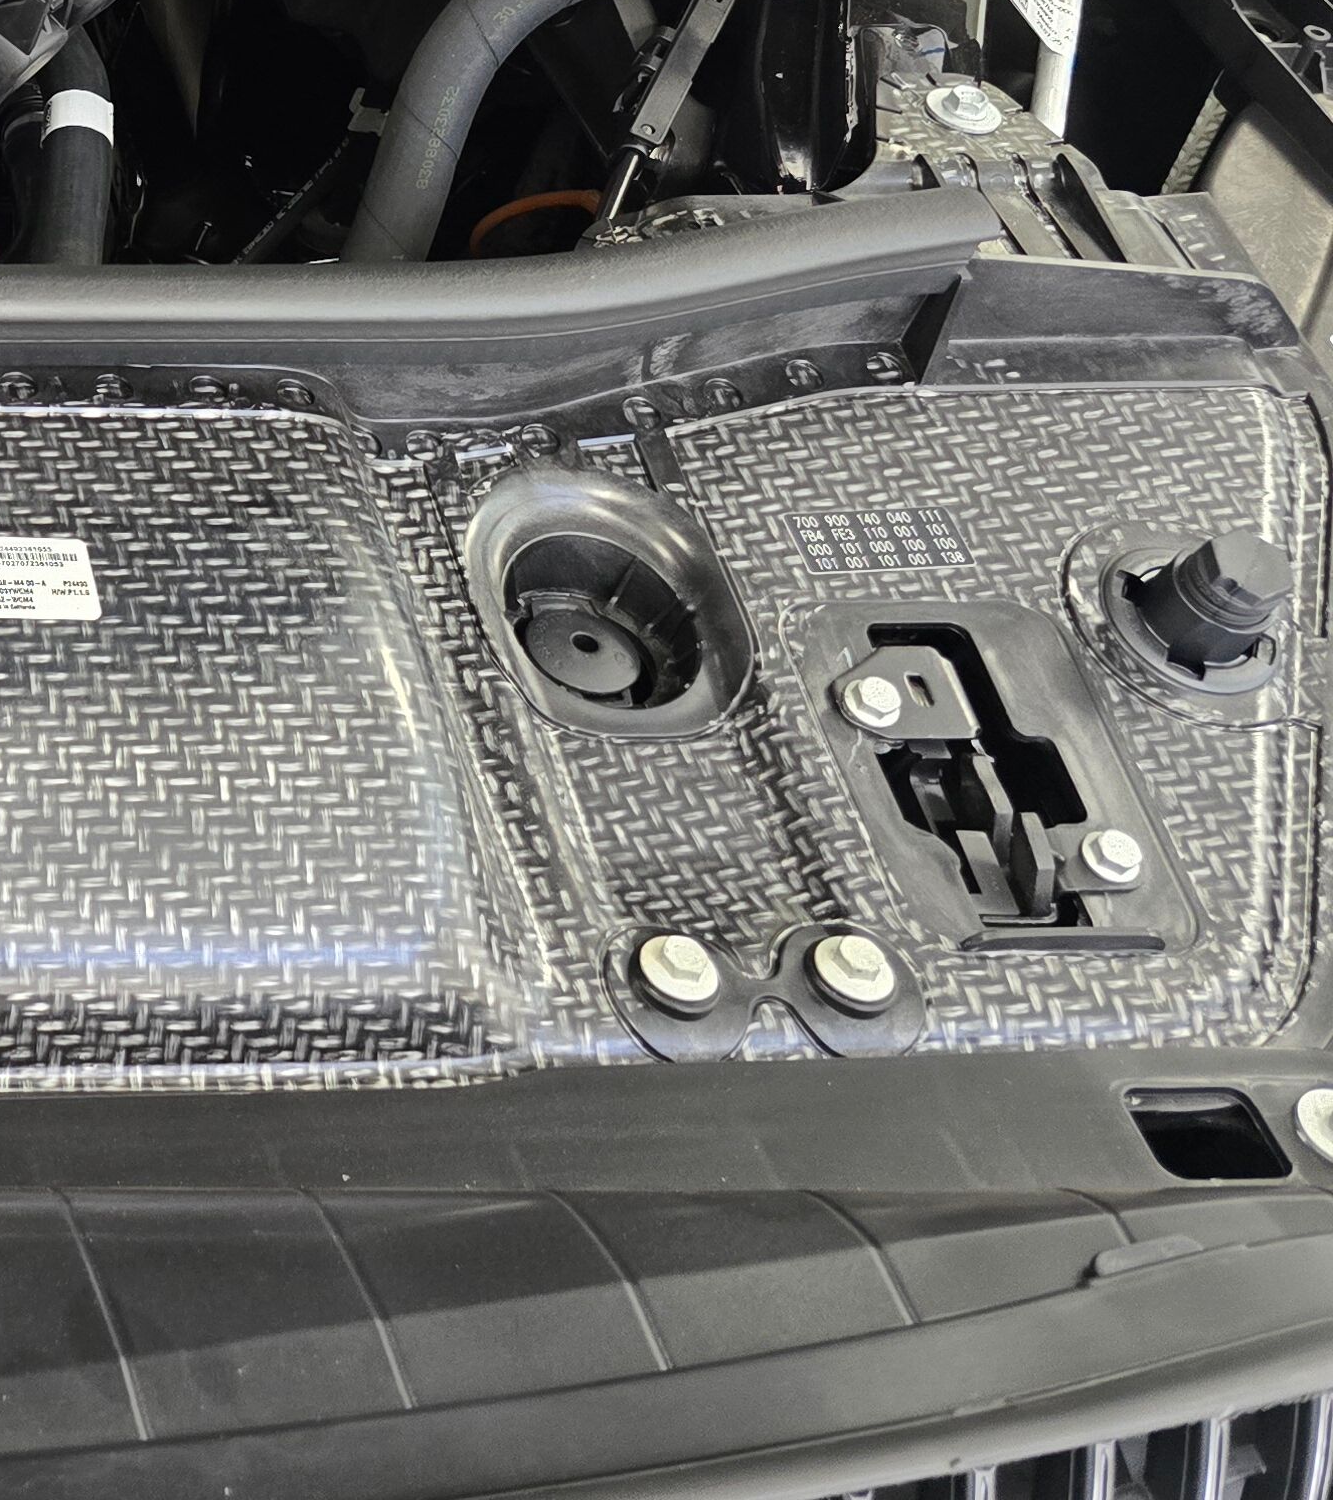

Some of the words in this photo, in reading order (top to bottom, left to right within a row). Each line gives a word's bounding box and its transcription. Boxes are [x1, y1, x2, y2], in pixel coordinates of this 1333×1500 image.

[792, 515, 818, 529] 700
[824, 514, 849, 527] 900
[857, 513, 881, 526] 140
[885, 511, 911, 524] 040
[918, 509, 942, 522] 111
[799, 530, 824, 542] FB4
[831, 528, 856, 541] FE3
[863, 526, 888, 539] 110
[892, 525, 918, 538] 001
[925, 523, 950, 536] 101
[806, 544, 832, 556] 000
[839, 542, 863, 555] 101
[869, 541, 895, 553] 000
[902, 539, 927, 552] 100
[933, 537, 958, 550] 100
[815, 557, 839, 571] 101
[845, 556, 870, 569] 001
[877, 554, 902, 567] 101
[908, 552, 933, 565] 001
[940, 551, 966, 564] 138
